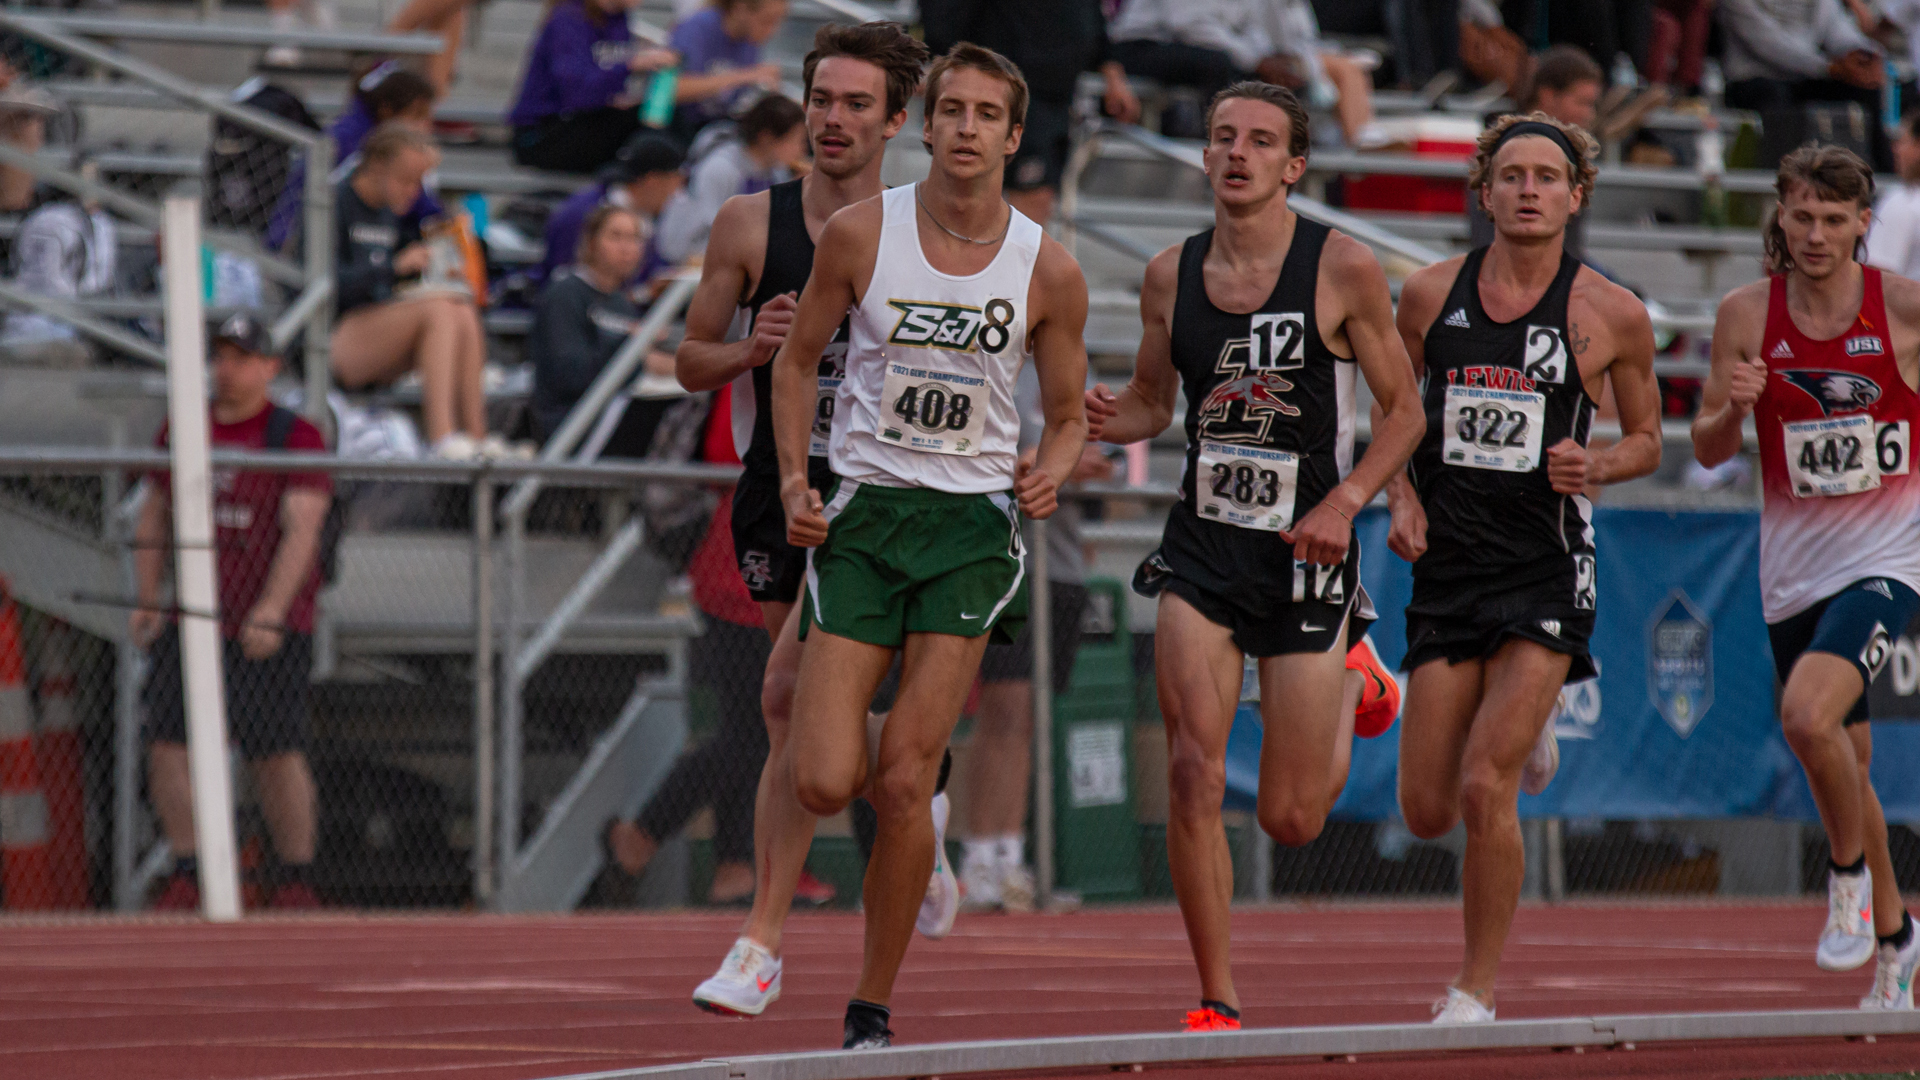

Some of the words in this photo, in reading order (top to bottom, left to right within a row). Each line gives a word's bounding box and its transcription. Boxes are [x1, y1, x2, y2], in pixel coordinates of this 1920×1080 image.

[895, 305, 981, 346] S&T
[978, 298, 1015, 355] 8
[1252, 319, 1304, 367] 12
[1444, 319, 1471, 328] adidas
[1525, 328, 1560, 381] 2
[1847, 338, 1882, 352] USI
[893, 364, 909, 376] 2021
[910, 368, 927, 379] GLVC
[928, 371, 985, 387] CHAMPIONSHIPS
[1446, 365, 1537, 393] LEWIS
[1452, 387, 1468, 396] 2021
[1468, 390, 1484, 399] GLVC
[1485, 391, 1538, 404] CHAMPIONSHIPS
[895, 386, 971, 431] 408
[1459, 406, 1528, 448] 322
[1206, 443, 1221, 453] 2021
[1222, 445, 1236, 456] GLVC
[1237, 448, 1291, 462] CHAMPIONSHIPS
[1800, 436, 1864, 475] 442
[1876, 422, 1903, 474] 6
[1212, 463, 1278, 507] 283
